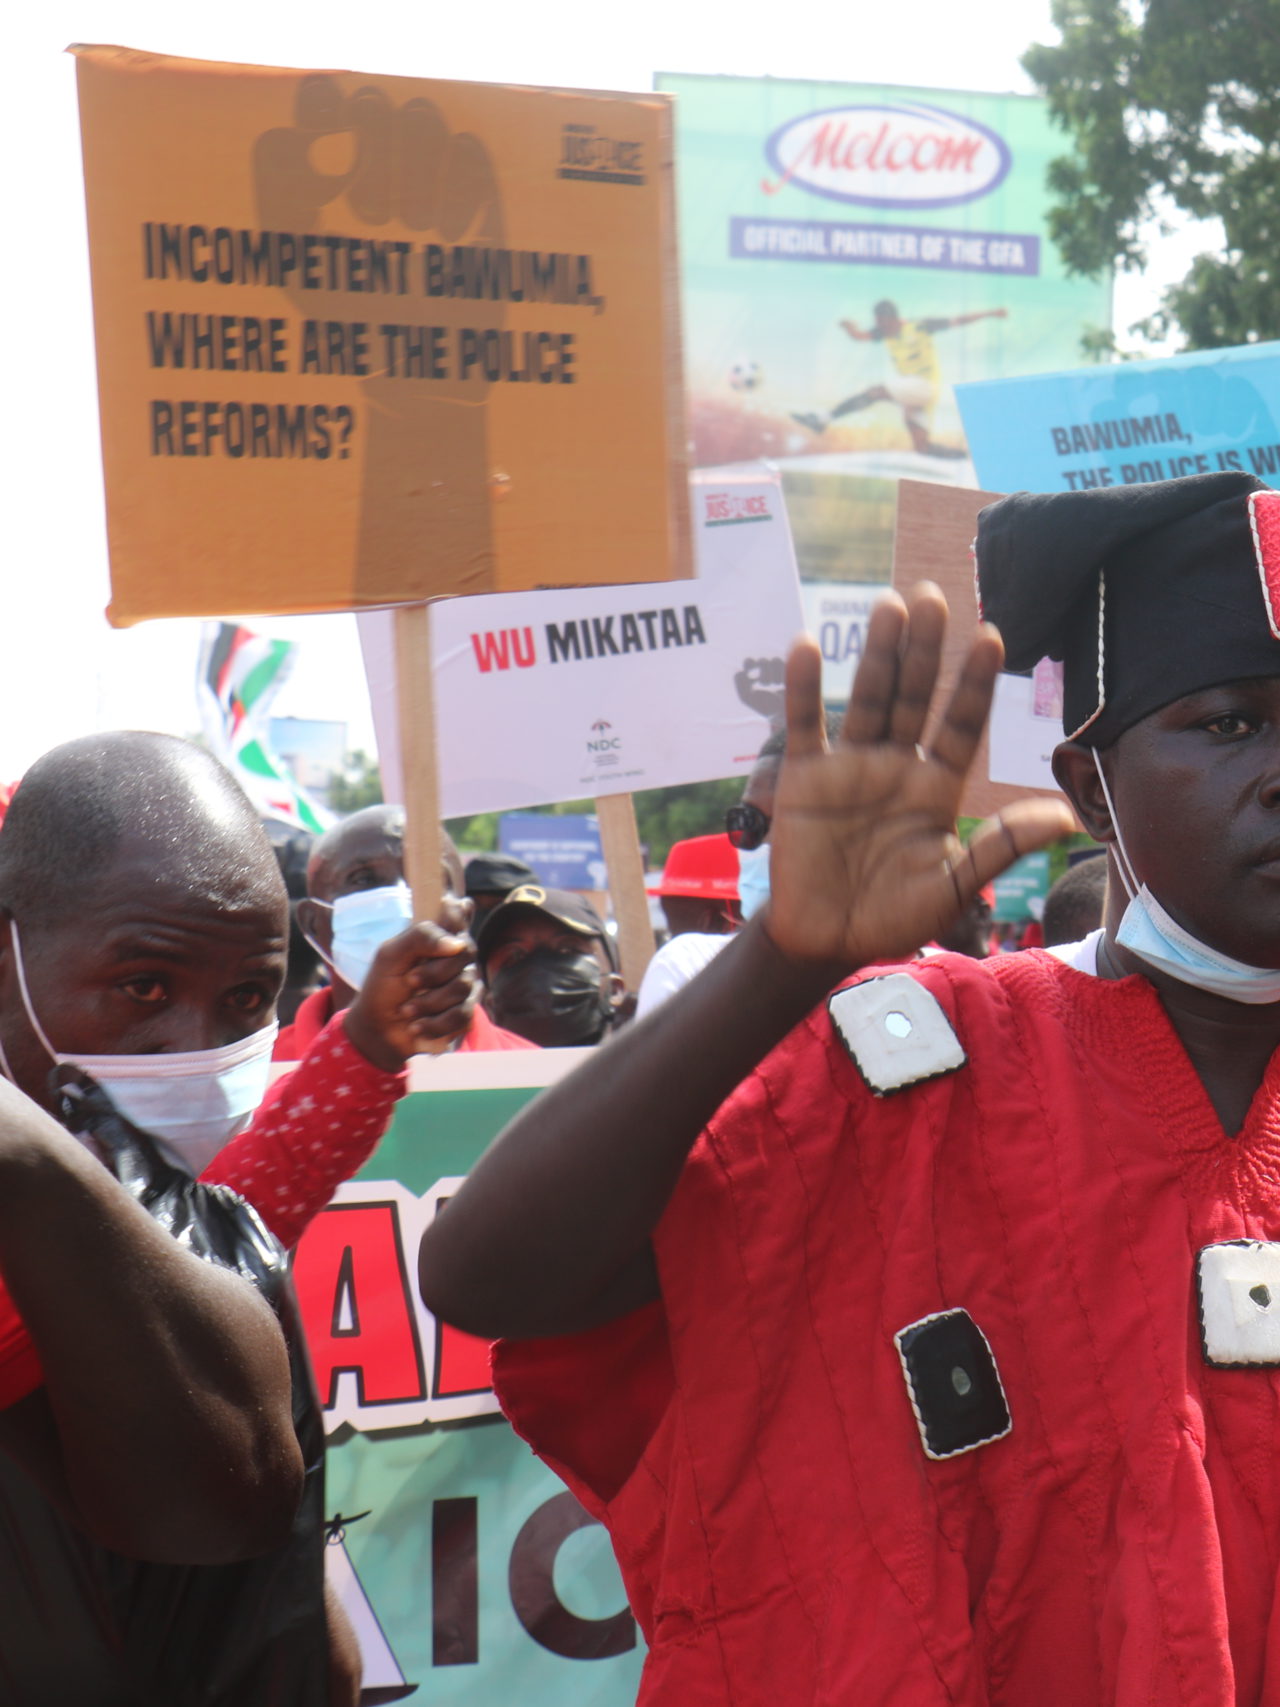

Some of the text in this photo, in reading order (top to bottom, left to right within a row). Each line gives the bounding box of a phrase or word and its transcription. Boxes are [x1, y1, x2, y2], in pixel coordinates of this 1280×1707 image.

[760, 120, 984, 196] Melcom
[143, 222, 605, 315] INCOMPETENT BAWUMIA,
[744, 225, 1025, 267] OFFICIAL PARTNER OF THE GFA
[146, 311, 576, 384] WHERE ARE THE POLICE
[151, 400, 354, 460] REFORMS?
[1051, 412, 1192, 456] BAWUMIA,
[1062, 467, 1113, 492] THE
[1120, 454, 1209, 487] POLICE
[1216, 449, 1243, 473] IS
[471, 605, 706, 672] WU MIKATAA
[820, 621, 869, 663] QA
[587, 738, 622, 752] NDC
